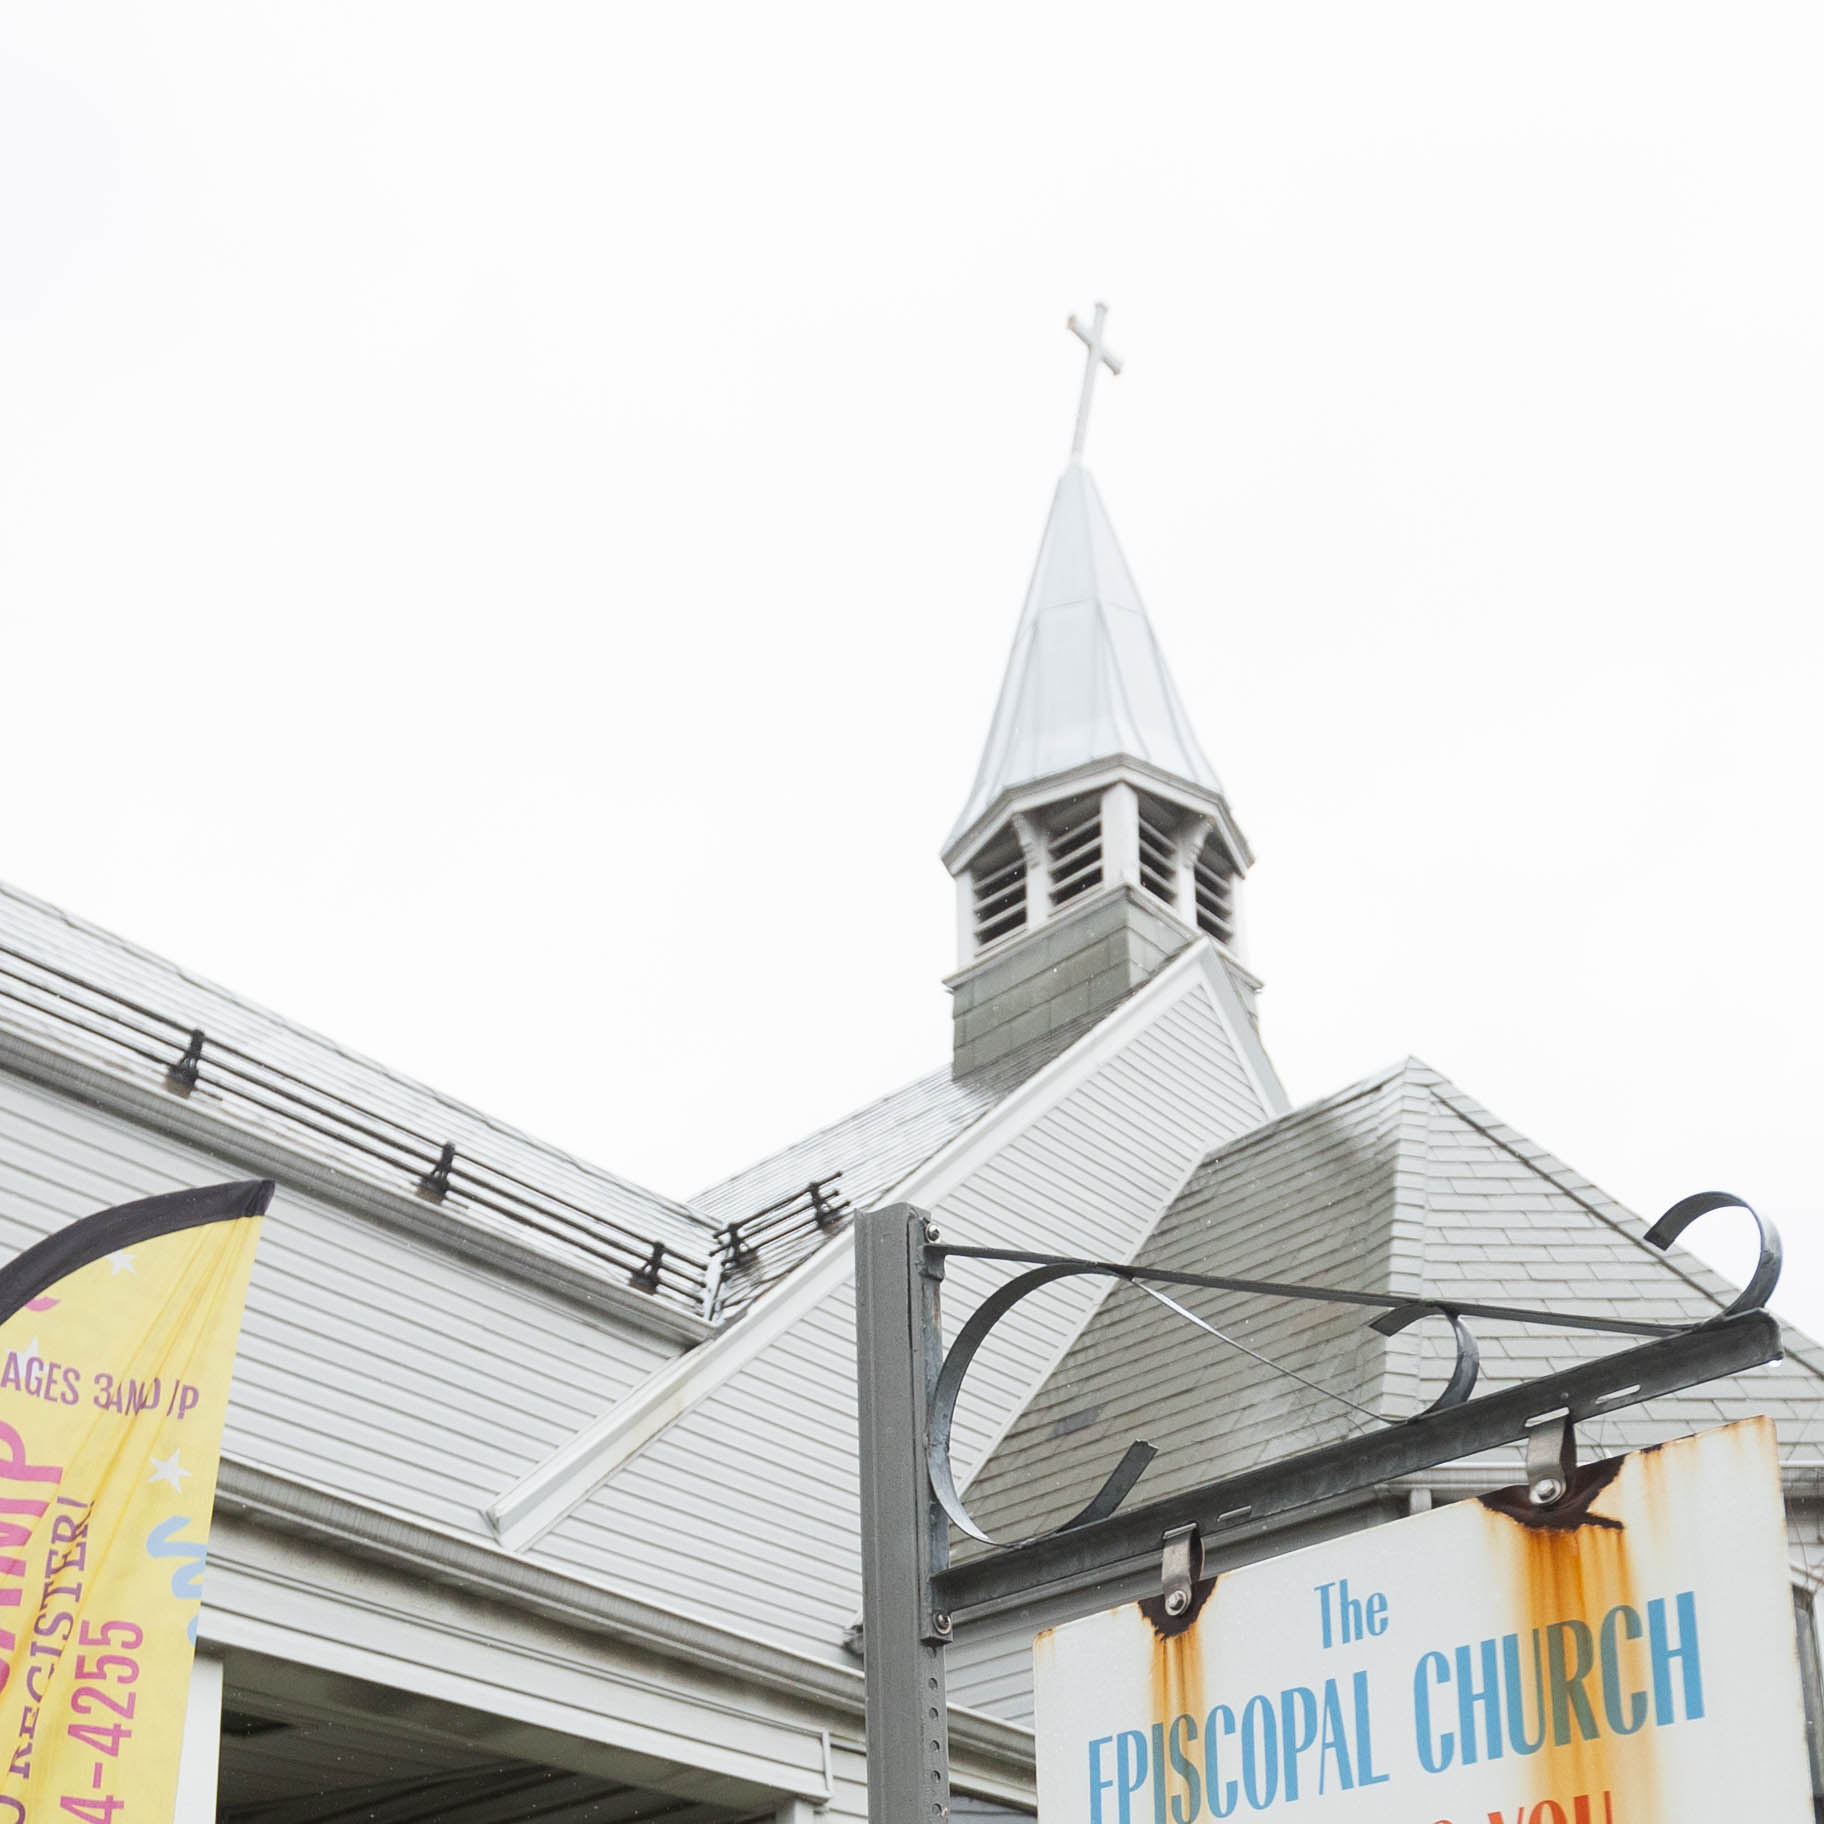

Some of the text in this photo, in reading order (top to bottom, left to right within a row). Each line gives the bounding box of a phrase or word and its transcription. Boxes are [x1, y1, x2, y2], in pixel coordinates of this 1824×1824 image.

[0, 1351, 81, 1405] AGES
[1314, 1578, 1390, 1650] The
[1413, 1590, 1706, 1774] CHURCH
